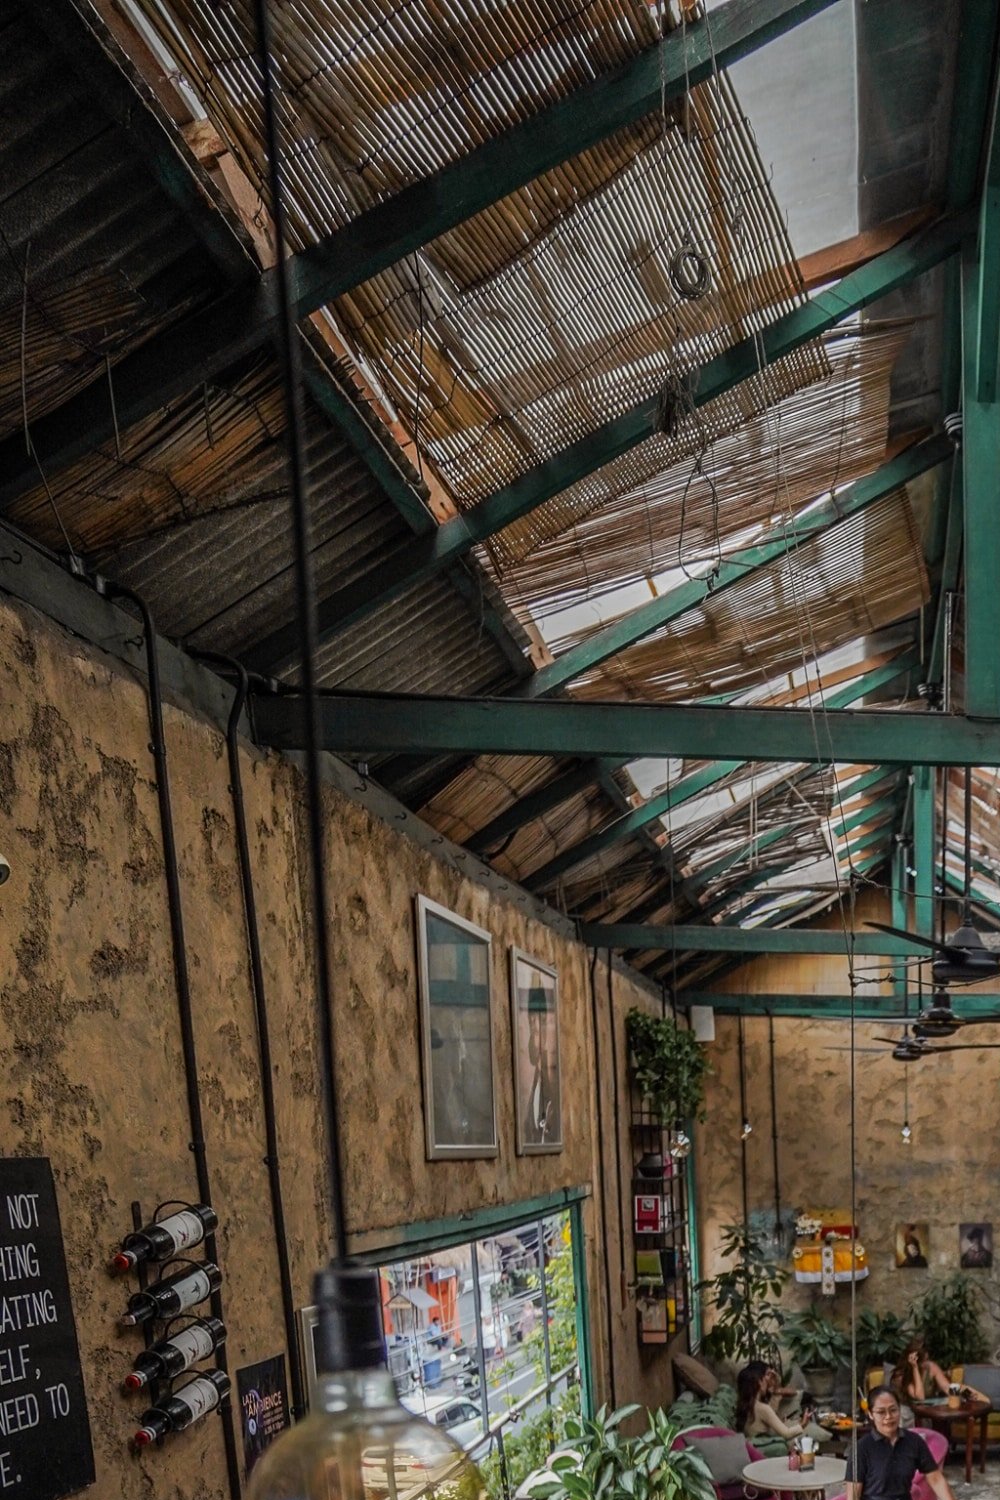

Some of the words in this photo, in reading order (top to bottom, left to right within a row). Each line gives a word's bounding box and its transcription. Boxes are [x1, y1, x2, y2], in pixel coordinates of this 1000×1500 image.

[7, 1193, 40, 1231] NOT
[0, 1289, 58, 1334] ATING
[44, 1383, 70, 1419] TO
